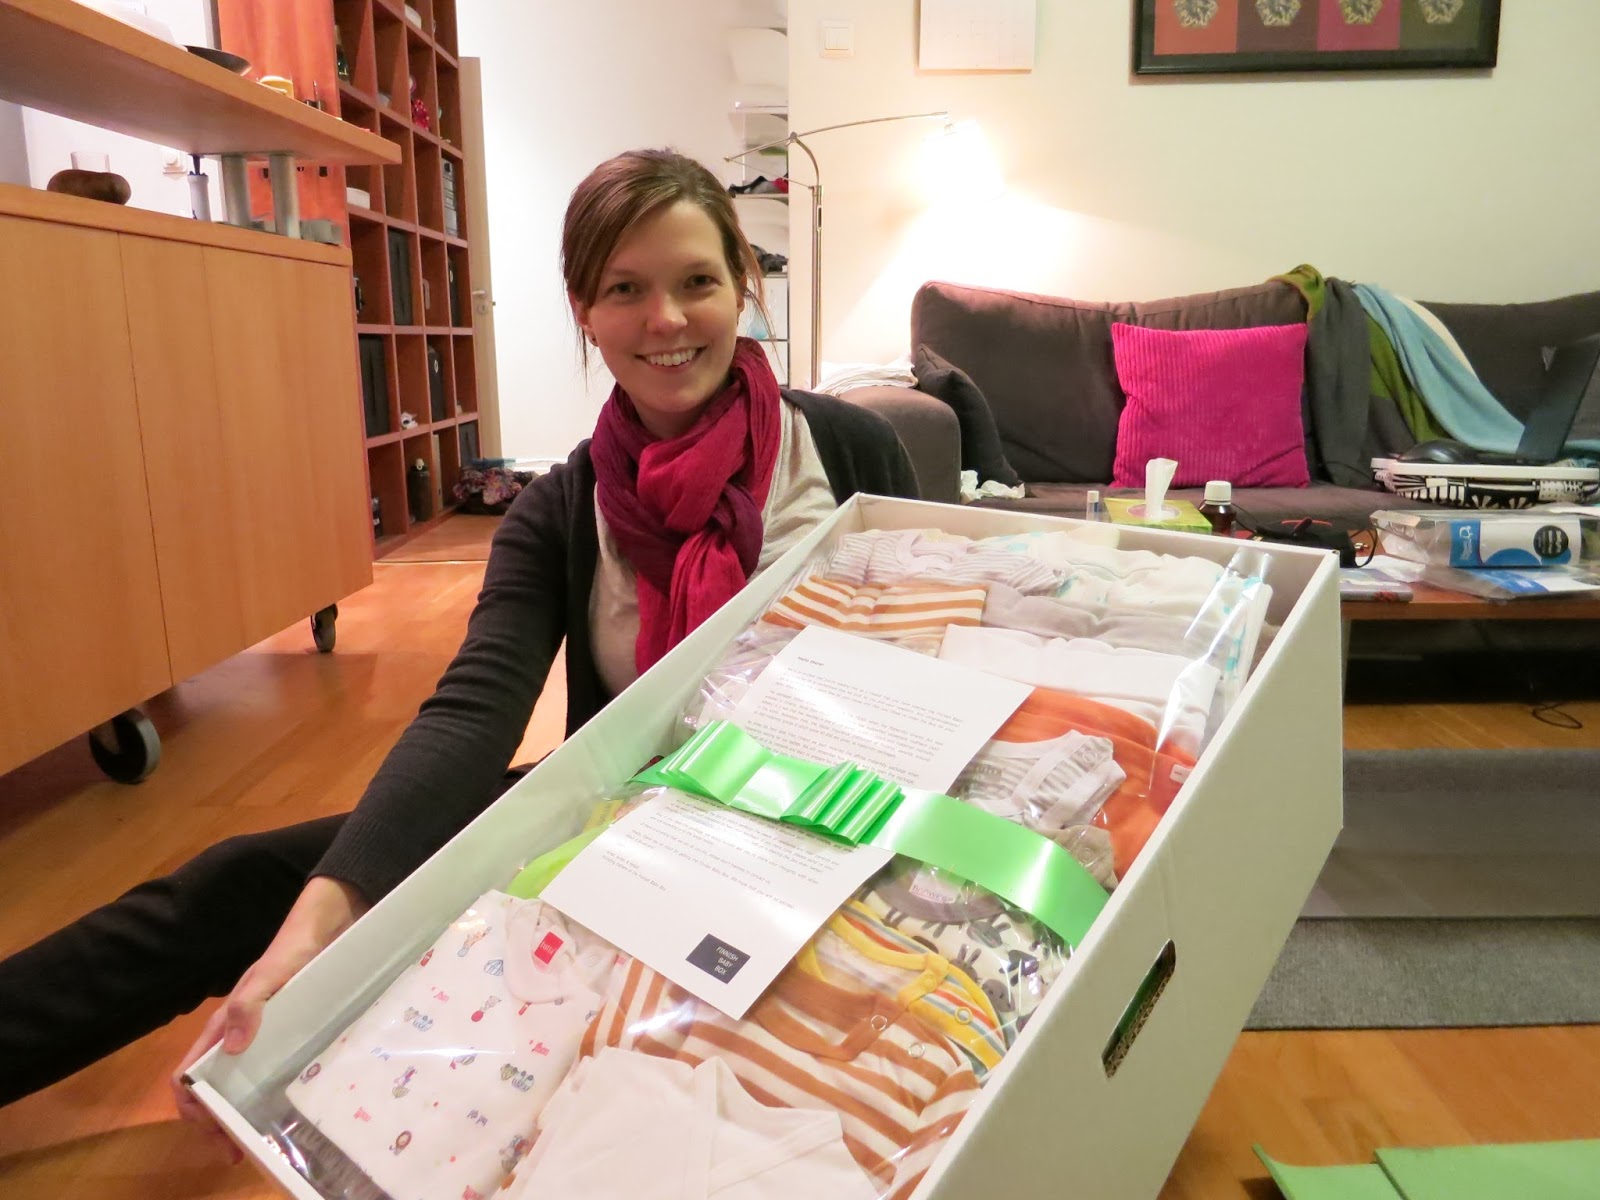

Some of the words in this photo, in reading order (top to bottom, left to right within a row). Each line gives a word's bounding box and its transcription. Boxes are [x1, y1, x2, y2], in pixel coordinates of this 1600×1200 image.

[716, 946, 739, 962] FINNISH
[717, 957, 734, 968] BABY
[714, 965, 728, 976] BOX
